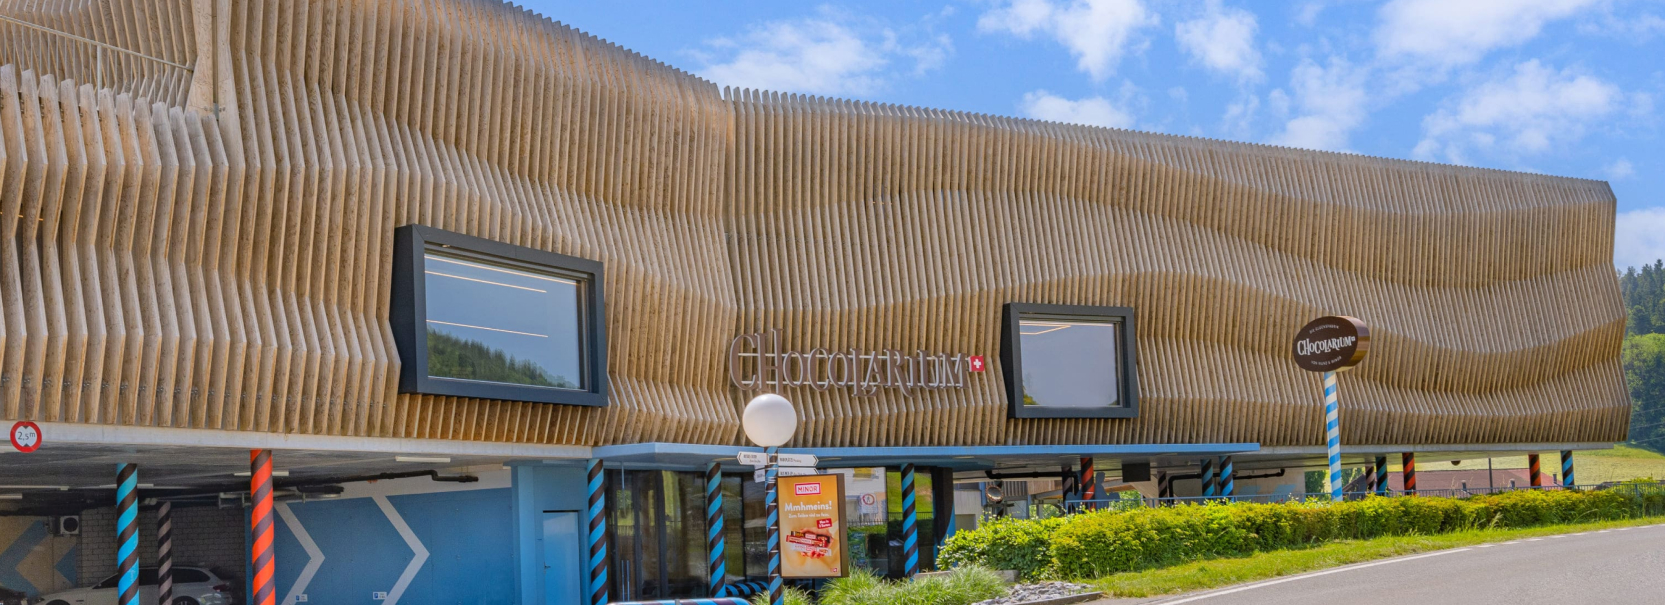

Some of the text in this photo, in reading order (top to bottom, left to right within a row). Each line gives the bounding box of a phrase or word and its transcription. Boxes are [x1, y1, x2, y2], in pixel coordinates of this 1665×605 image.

[1297, 336, 1352, 355] CHOCOLARIUM
[729, 328, 969, 397] CHOCOLARIUM
[785, 501, 832, 511] Mmhmeins!
